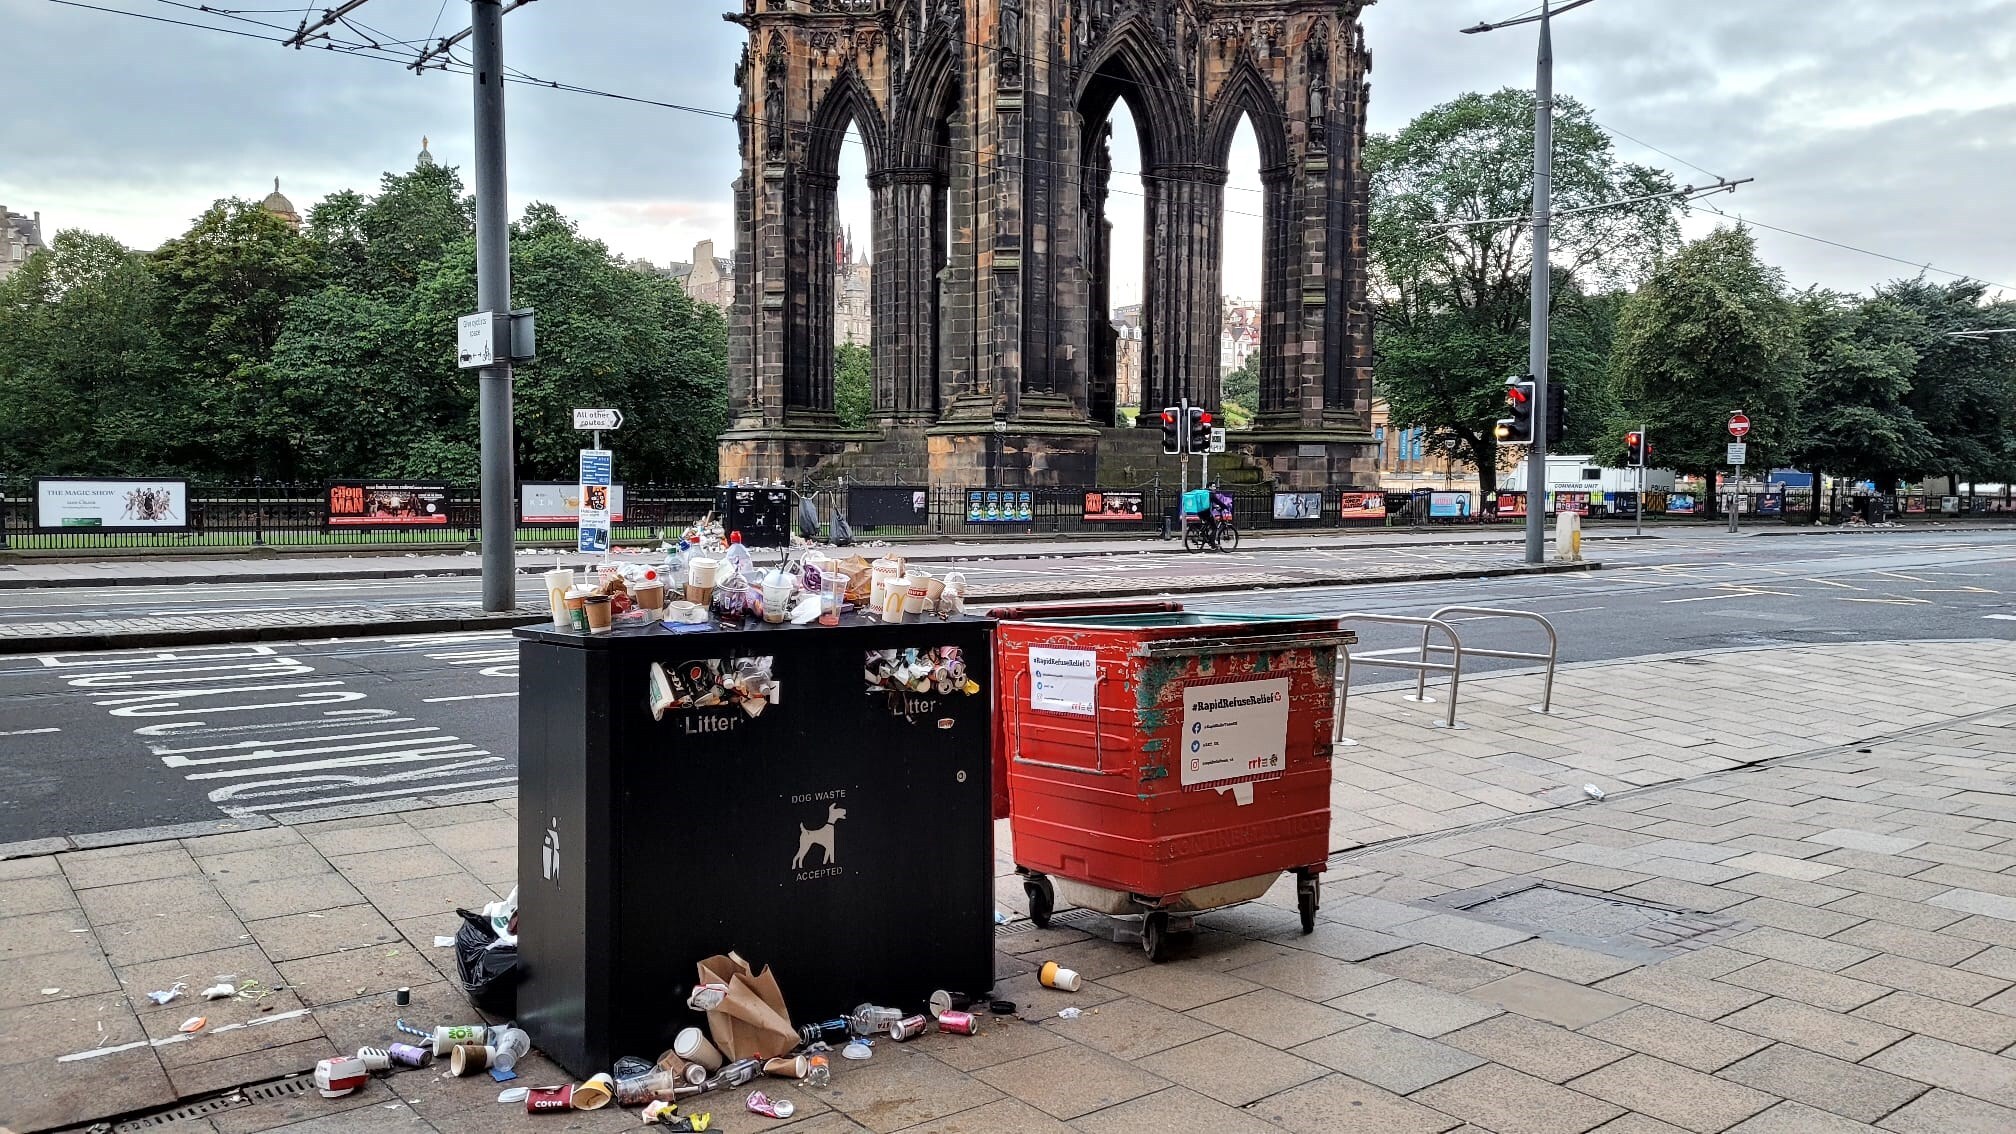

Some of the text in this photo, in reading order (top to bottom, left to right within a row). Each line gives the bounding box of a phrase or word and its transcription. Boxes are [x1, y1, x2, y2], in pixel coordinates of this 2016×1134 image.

[331, 487, 363, 498] CHOIR
[331, 498, 364, 513] MAN
[893, 699, 937, 716] Ltter
[1192, 692, 1274, 712] #RapidRefuseRelief
[685, 714, 738, 735] Litter
[791, 789, 846, 804] DOG WASTE
[795, 866, 843, 881] ACCEPTED
